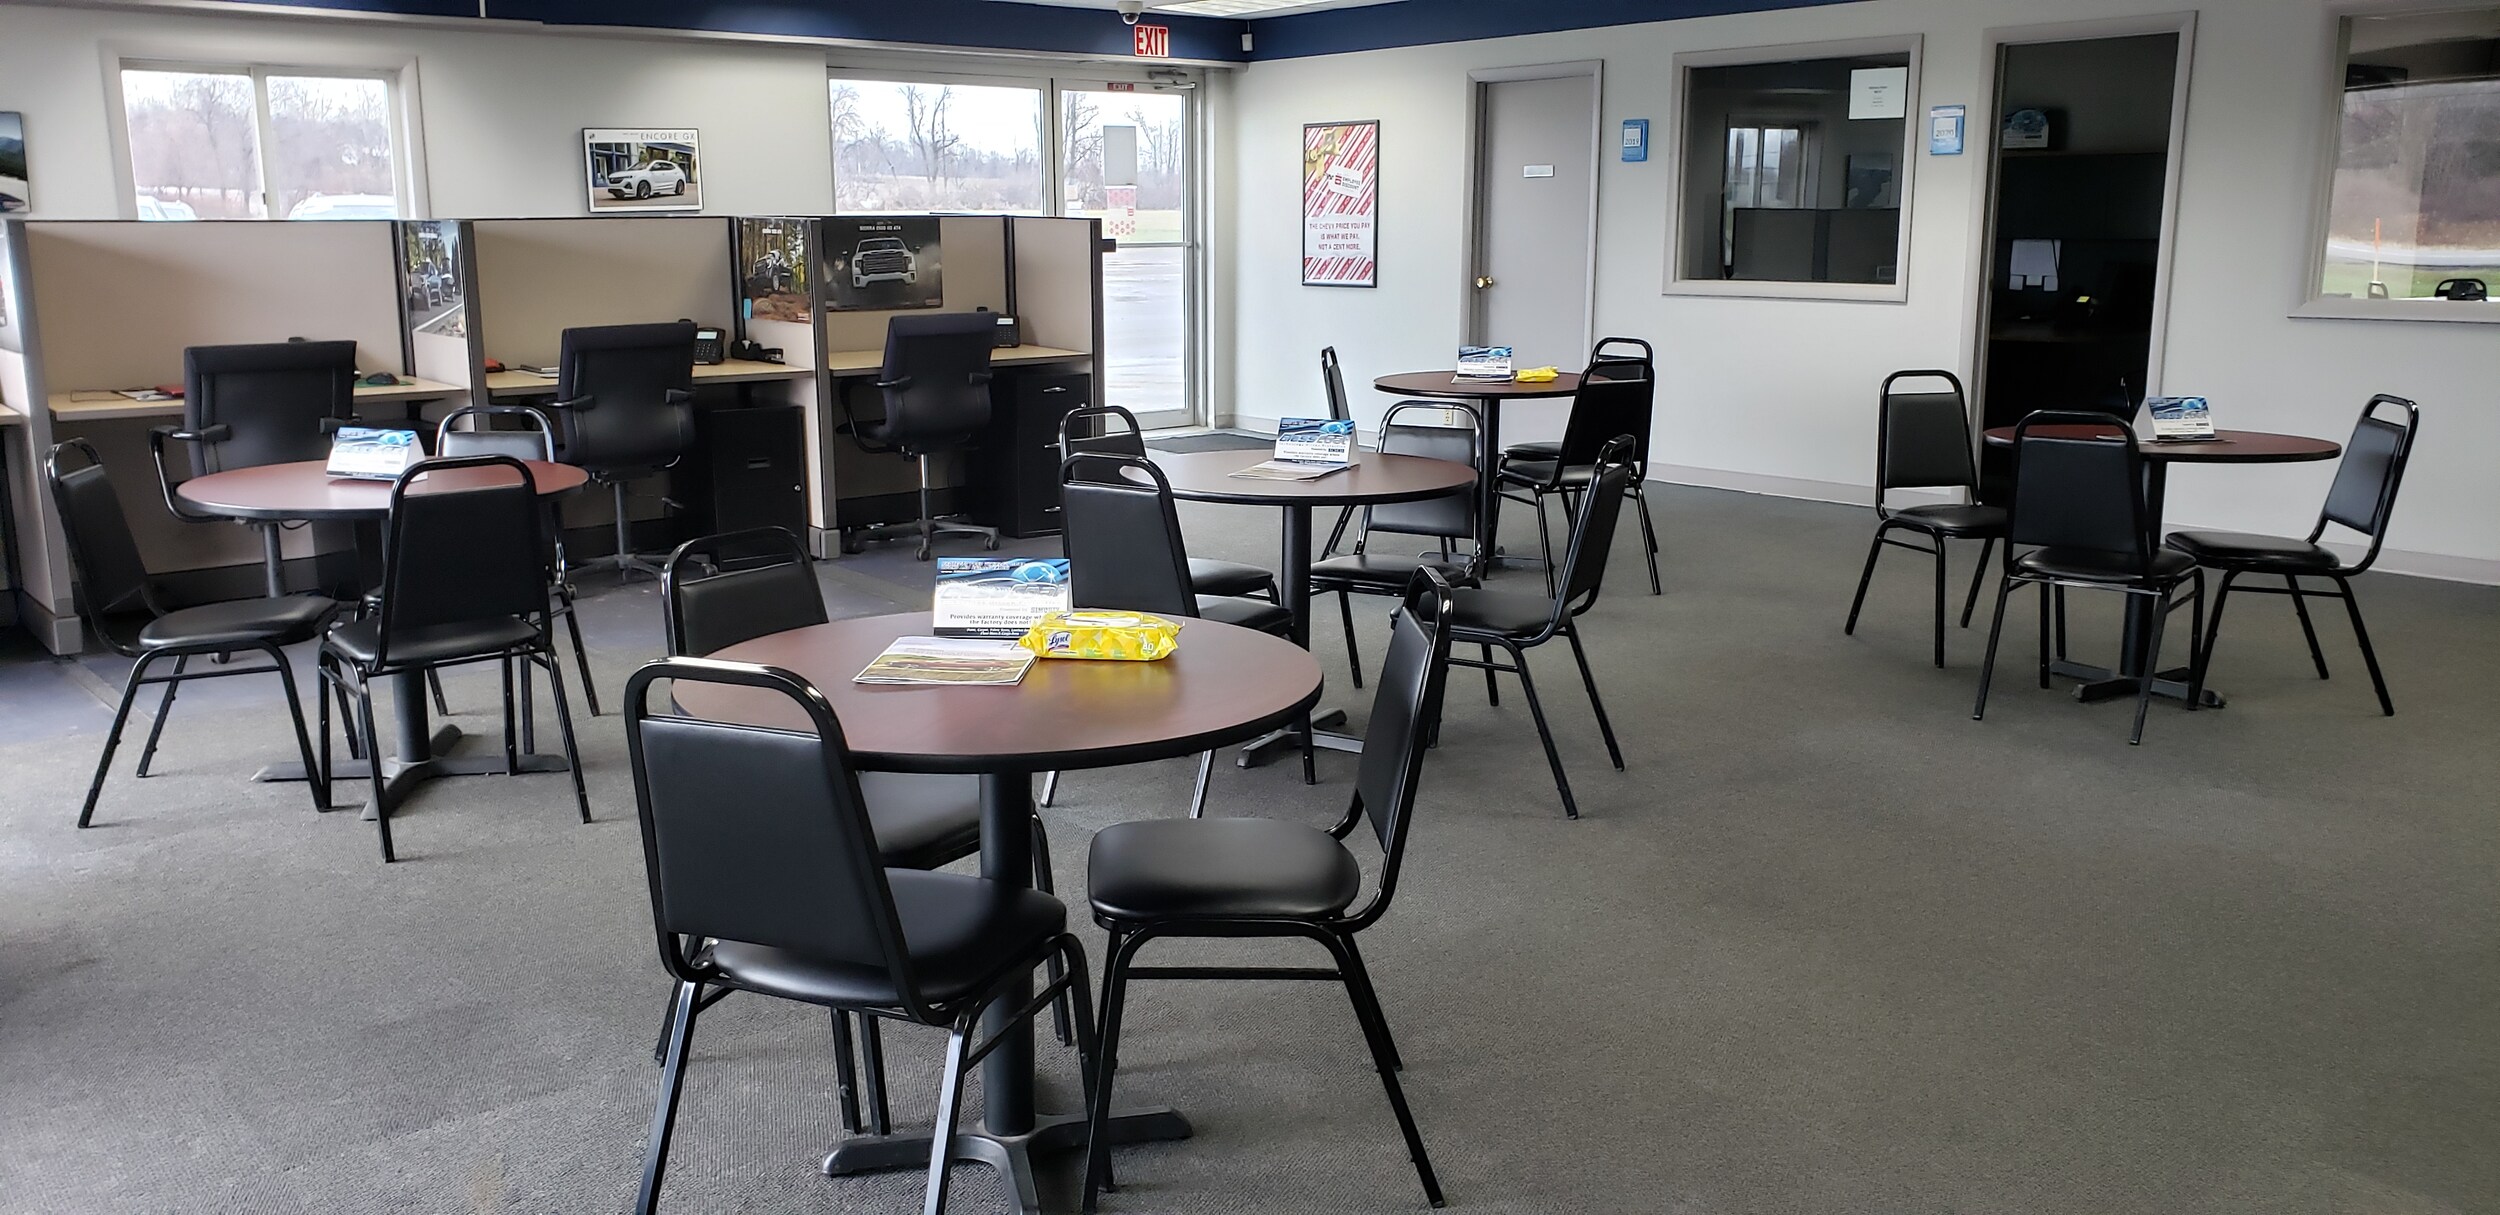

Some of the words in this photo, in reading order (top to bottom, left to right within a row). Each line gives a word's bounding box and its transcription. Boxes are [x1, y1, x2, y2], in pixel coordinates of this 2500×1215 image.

[1136, 26, 1167, 55] EXIT
[641, 132, 678, 140] ENCORE
[683, 132, 695, 140] GX
[1625, 138, 1640, 146] 2019
[1049, 633, 1070, 647] Lysol
[1142, 642, 1154, 651] 80
